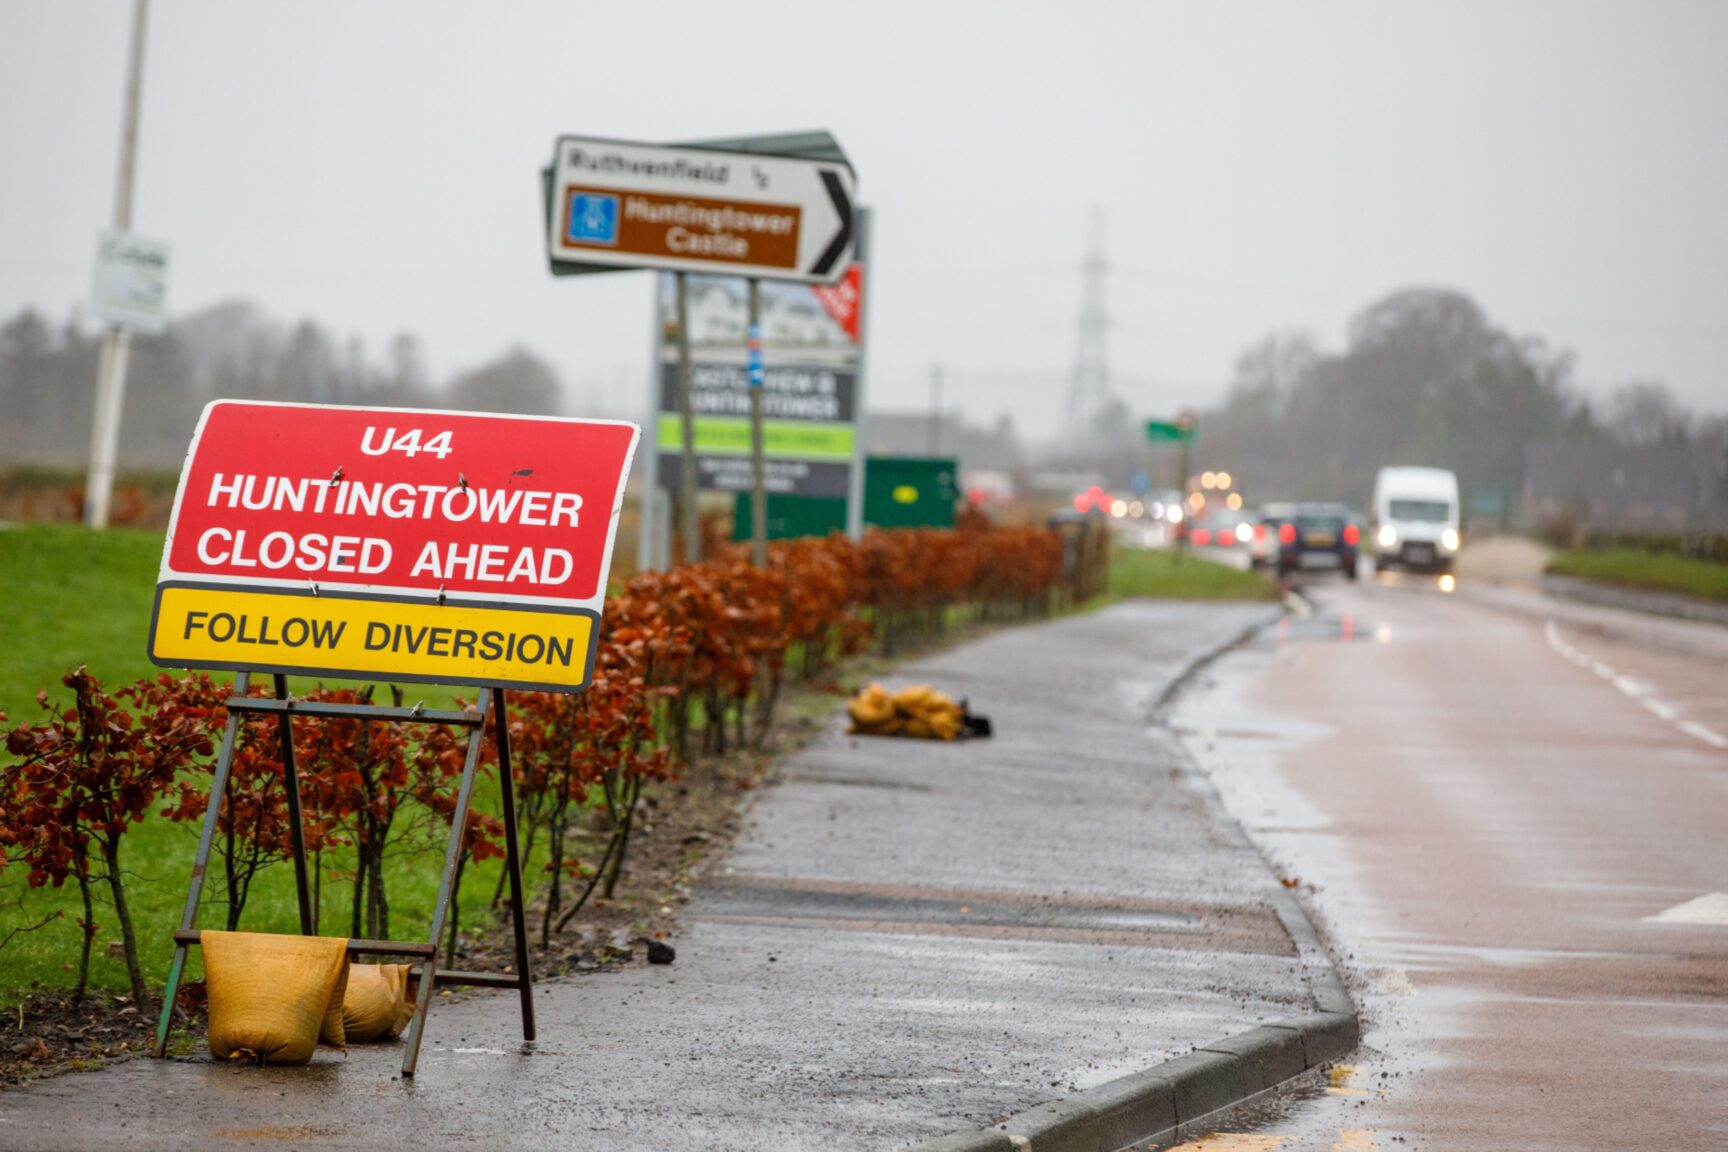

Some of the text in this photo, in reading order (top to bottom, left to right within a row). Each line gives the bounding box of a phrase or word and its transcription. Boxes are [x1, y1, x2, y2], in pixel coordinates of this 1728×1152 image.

[568, 148, 730, 182] Ruthvenfield
[624, 195, 796, 235] Huntingtower
[665, 226, 750, 258] Castle
[360, 426, 452, 459] U44
[207, 473, 584, 527] HUNTINGTOWER
[197, 527, 574, 585] CLOSED AHEAD
[183, 611, 574, 667] FOLLOW DIVERSION
